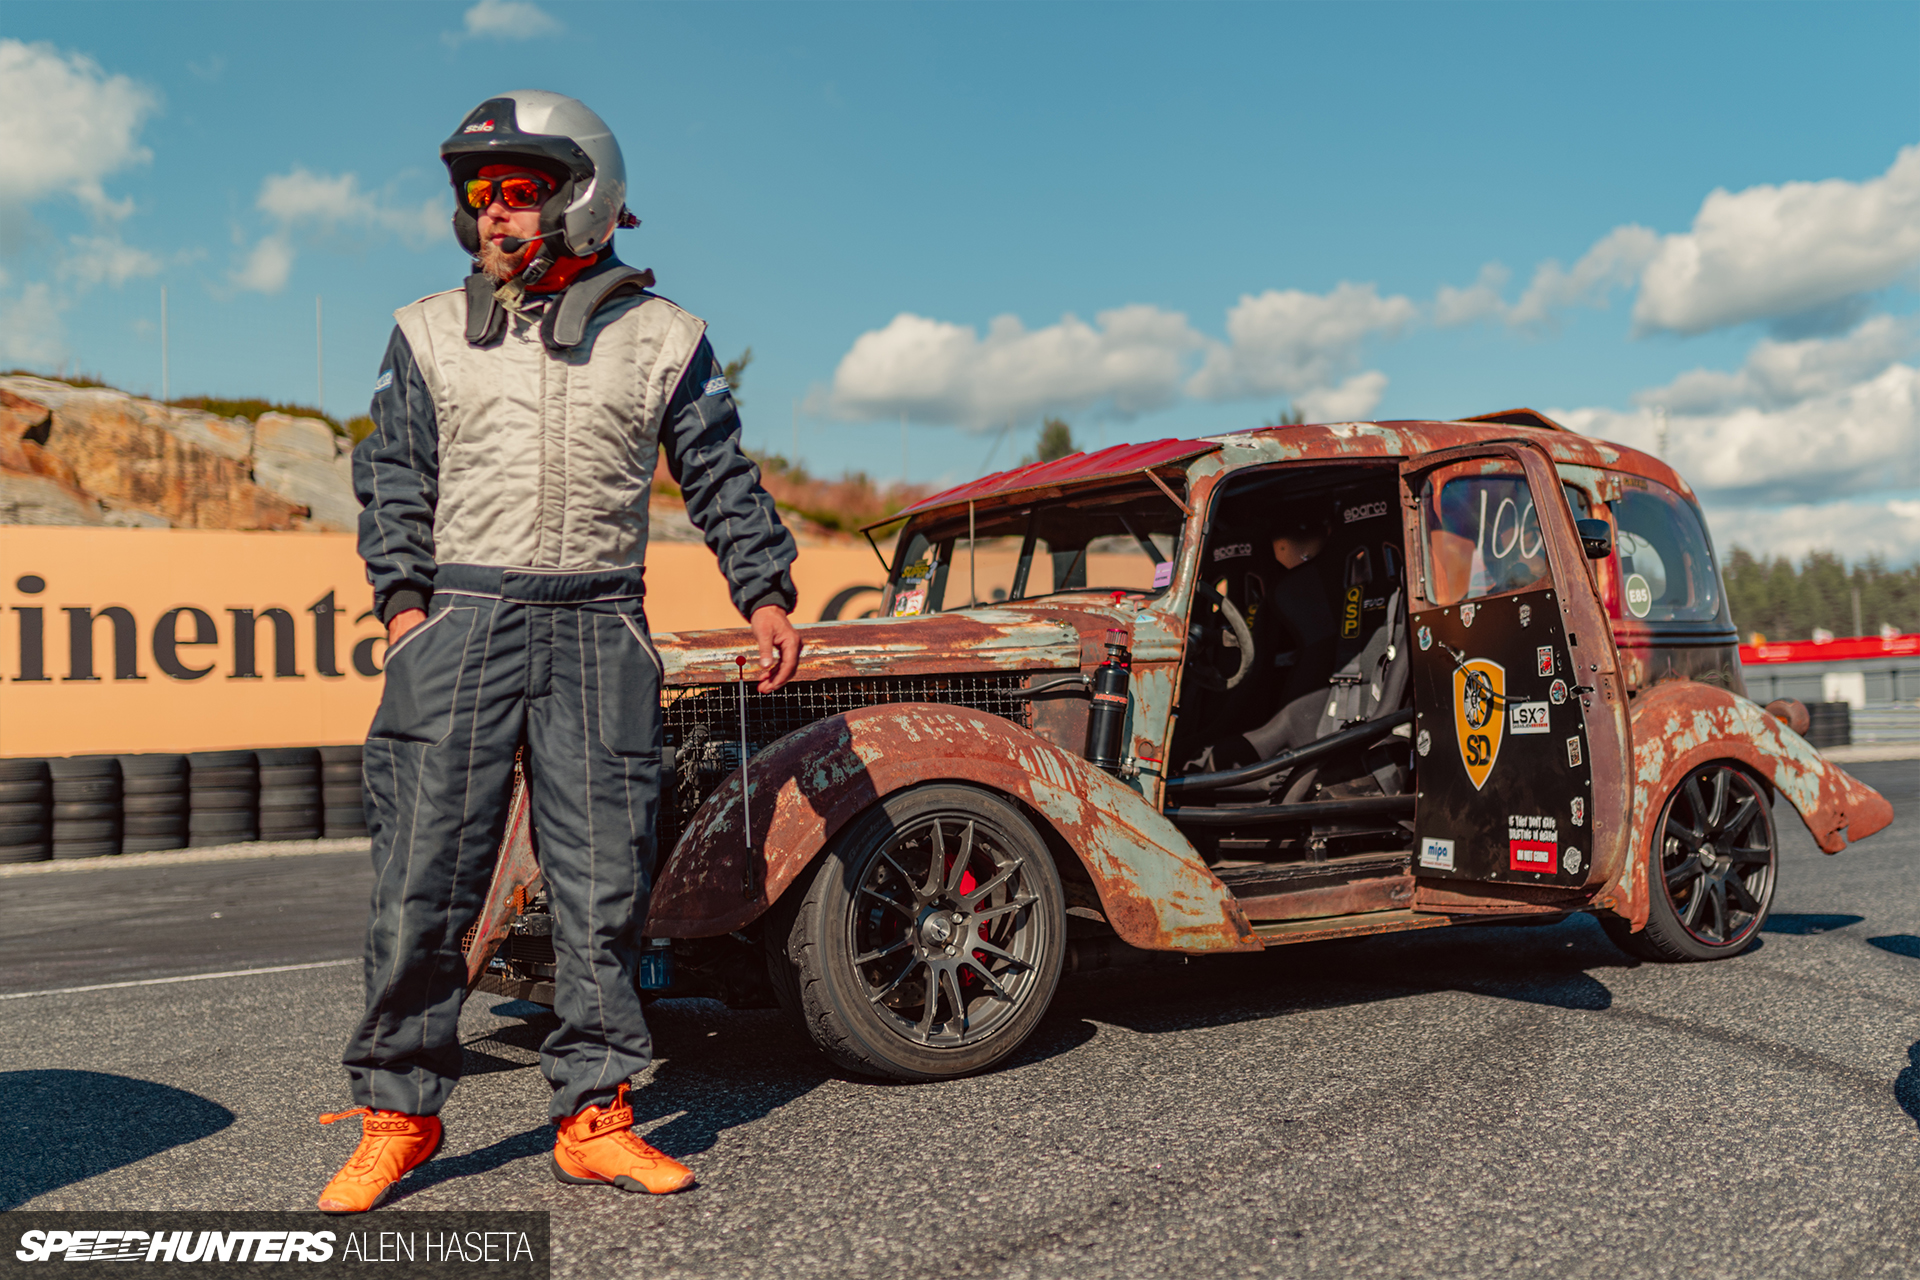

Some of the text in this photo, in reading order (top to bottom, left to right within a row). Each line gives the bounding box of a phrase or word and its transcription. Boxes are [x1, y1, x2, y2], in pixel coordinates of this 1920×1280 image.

[1629, 588, 1648, 603] E85
[0, 574, 384, 682] inenta
[1512, 708, 1537, 723] LSX
[1466, 734, 1491, 766] SD
[1427, 841, 1448, 862] mipa
